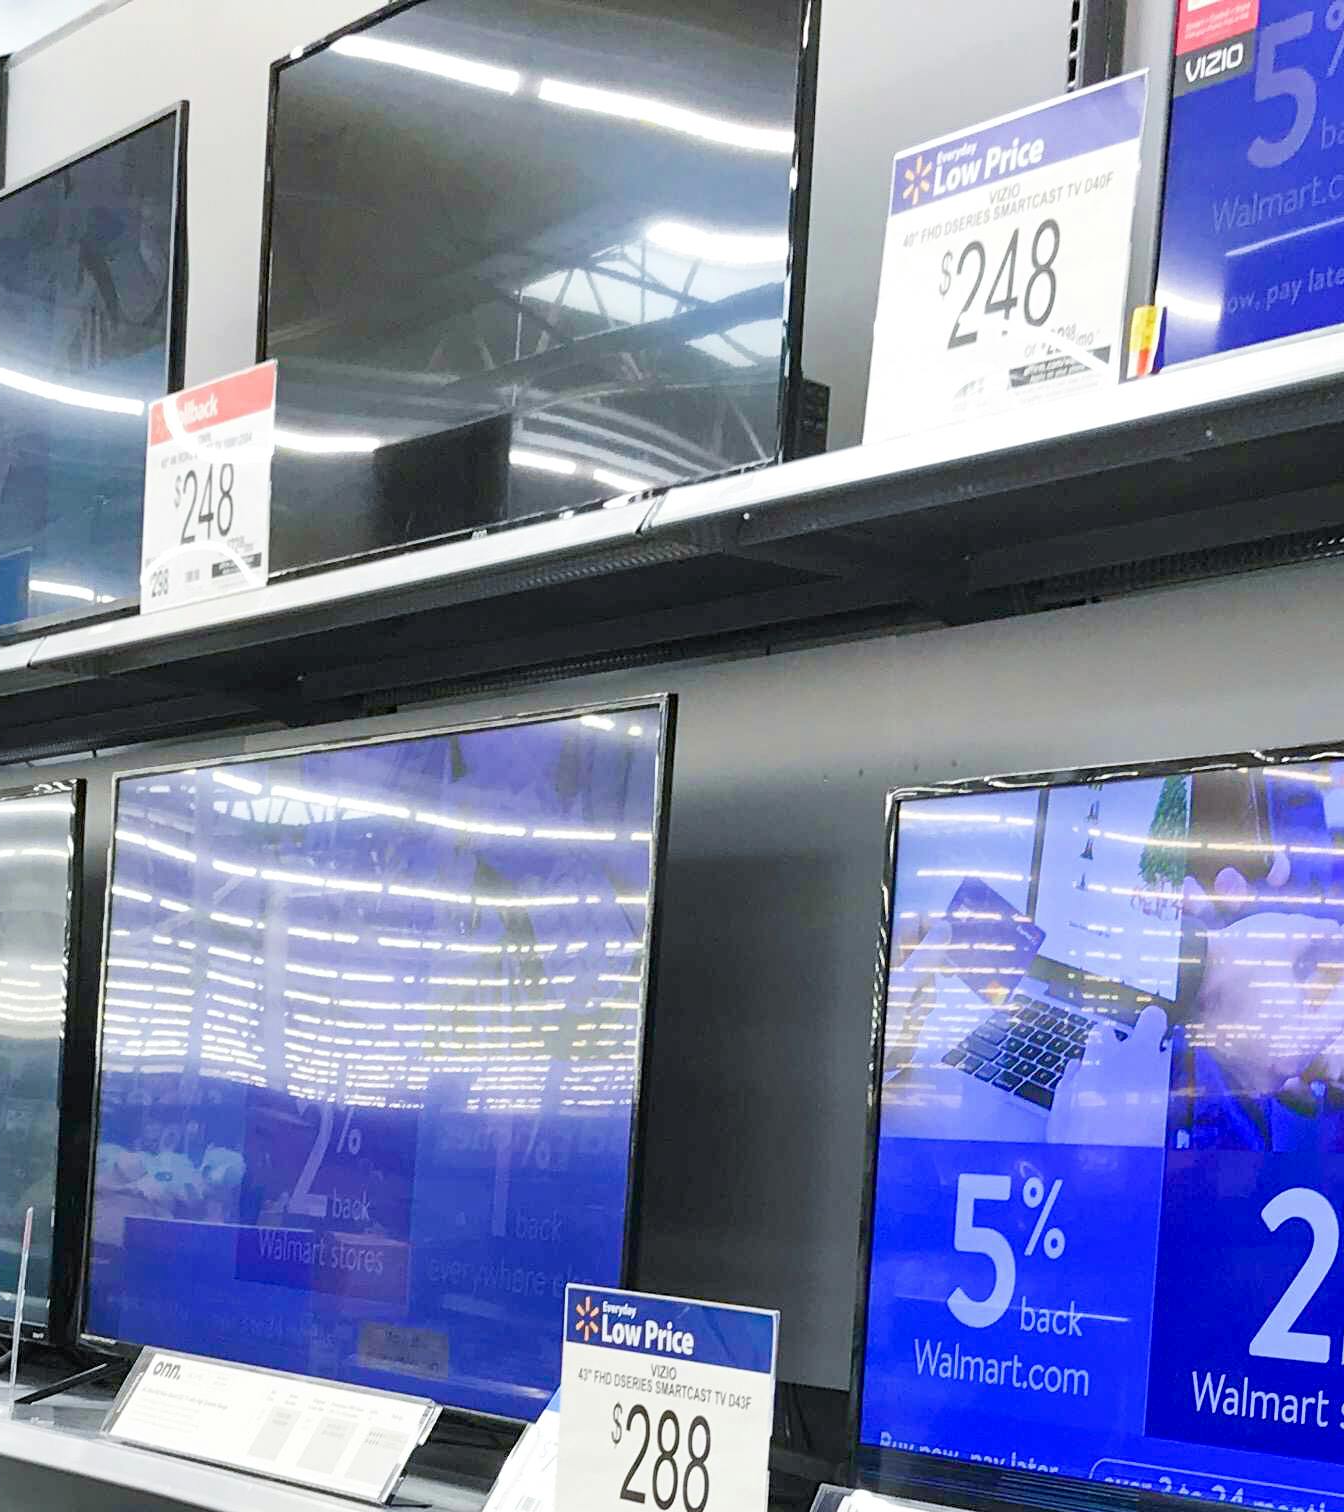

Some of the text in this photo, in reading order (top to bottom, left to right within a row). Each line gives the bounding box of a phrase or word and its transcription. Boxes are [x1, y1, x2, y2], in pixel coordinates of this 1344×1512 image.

[1184, 41, 1245, 83] VIZIO
[933, 136, 1045, 198] Low Price
[989, 183, 1021, 204] VIZIO
[939, 219, 1061, 349] $248
[331, 1191, 371, 1222] back
[257, 1226, 385, 1274] Walmart stores
[601, 1314, 695, 1355] Low Price
[1019, 1302, 1083, 1337] back
[153, 1360, 181, 1381] onn.
[650, 1363, 677, 1380] VIZIO
[914, 1338, 1089, 1396] Walmart.com
[594, 1370, 612, 1386] FHD
[613, 1373, 653, 1393] DSERIES
[655, 1380, 711, 1403] SMARTCAST
[715, 1390, 727, 1405] TV
[728, 1392, 752, 1411] D43F
[1191, 1371, 1329, 1428] Walmart
